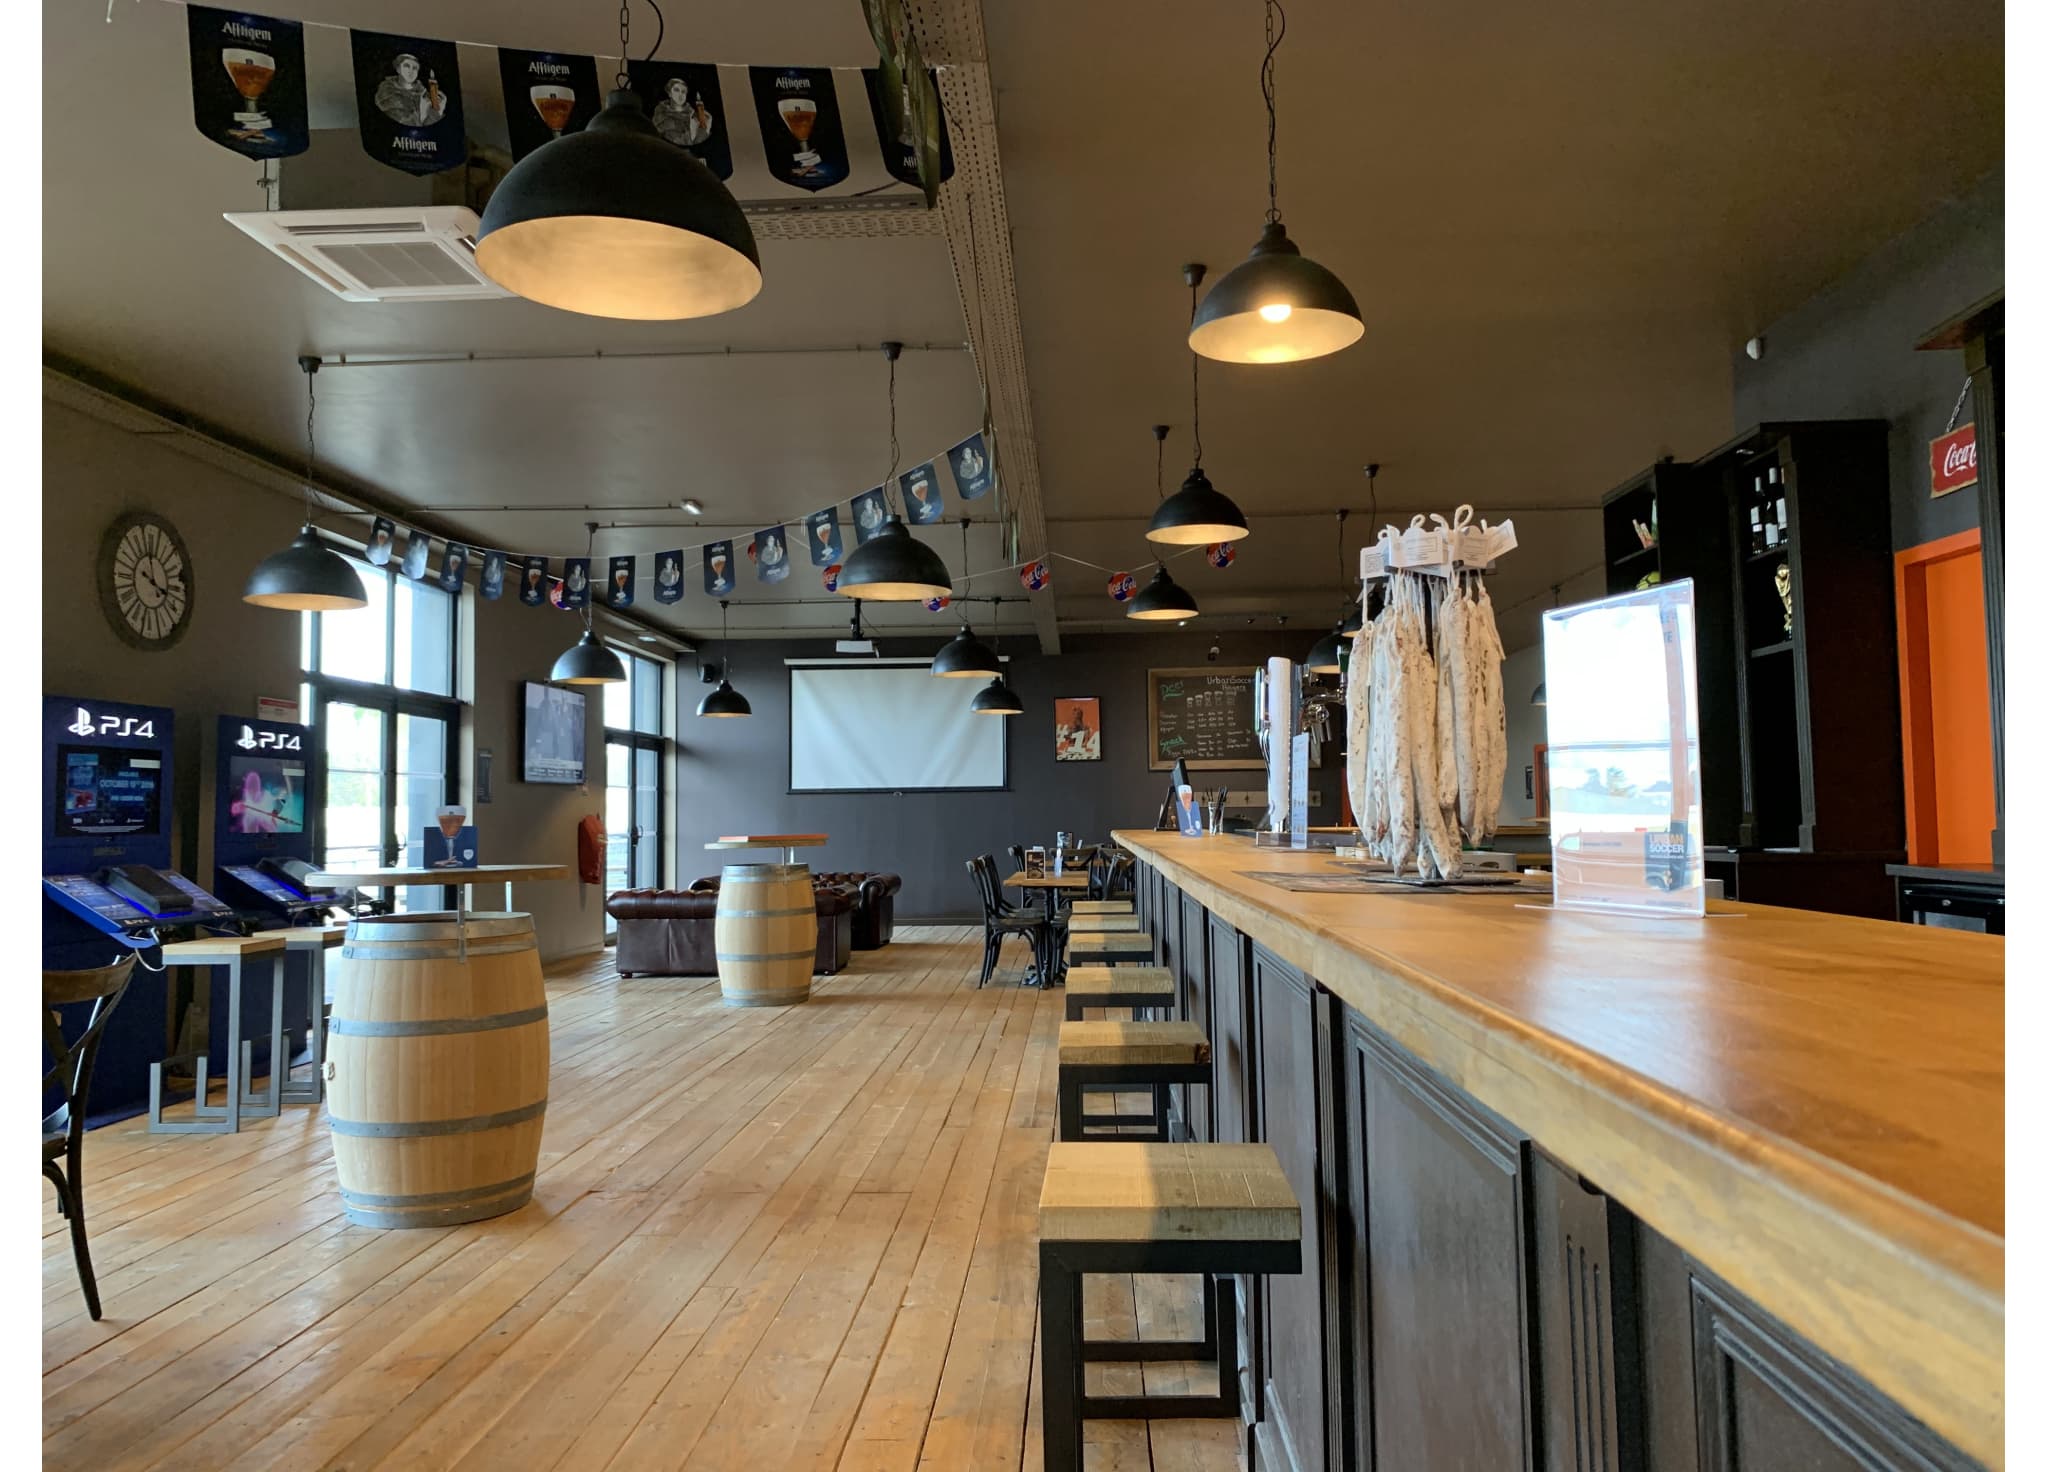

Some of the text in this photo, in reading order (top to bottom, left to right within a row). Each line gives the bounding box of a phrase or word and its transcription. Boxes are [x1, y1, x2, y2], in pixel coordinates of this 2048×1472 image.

[100, 715, 154, 738] PS4
[258, 731, 301, 750] PS4
[1650, 843, 1684, 854] SOCCER
